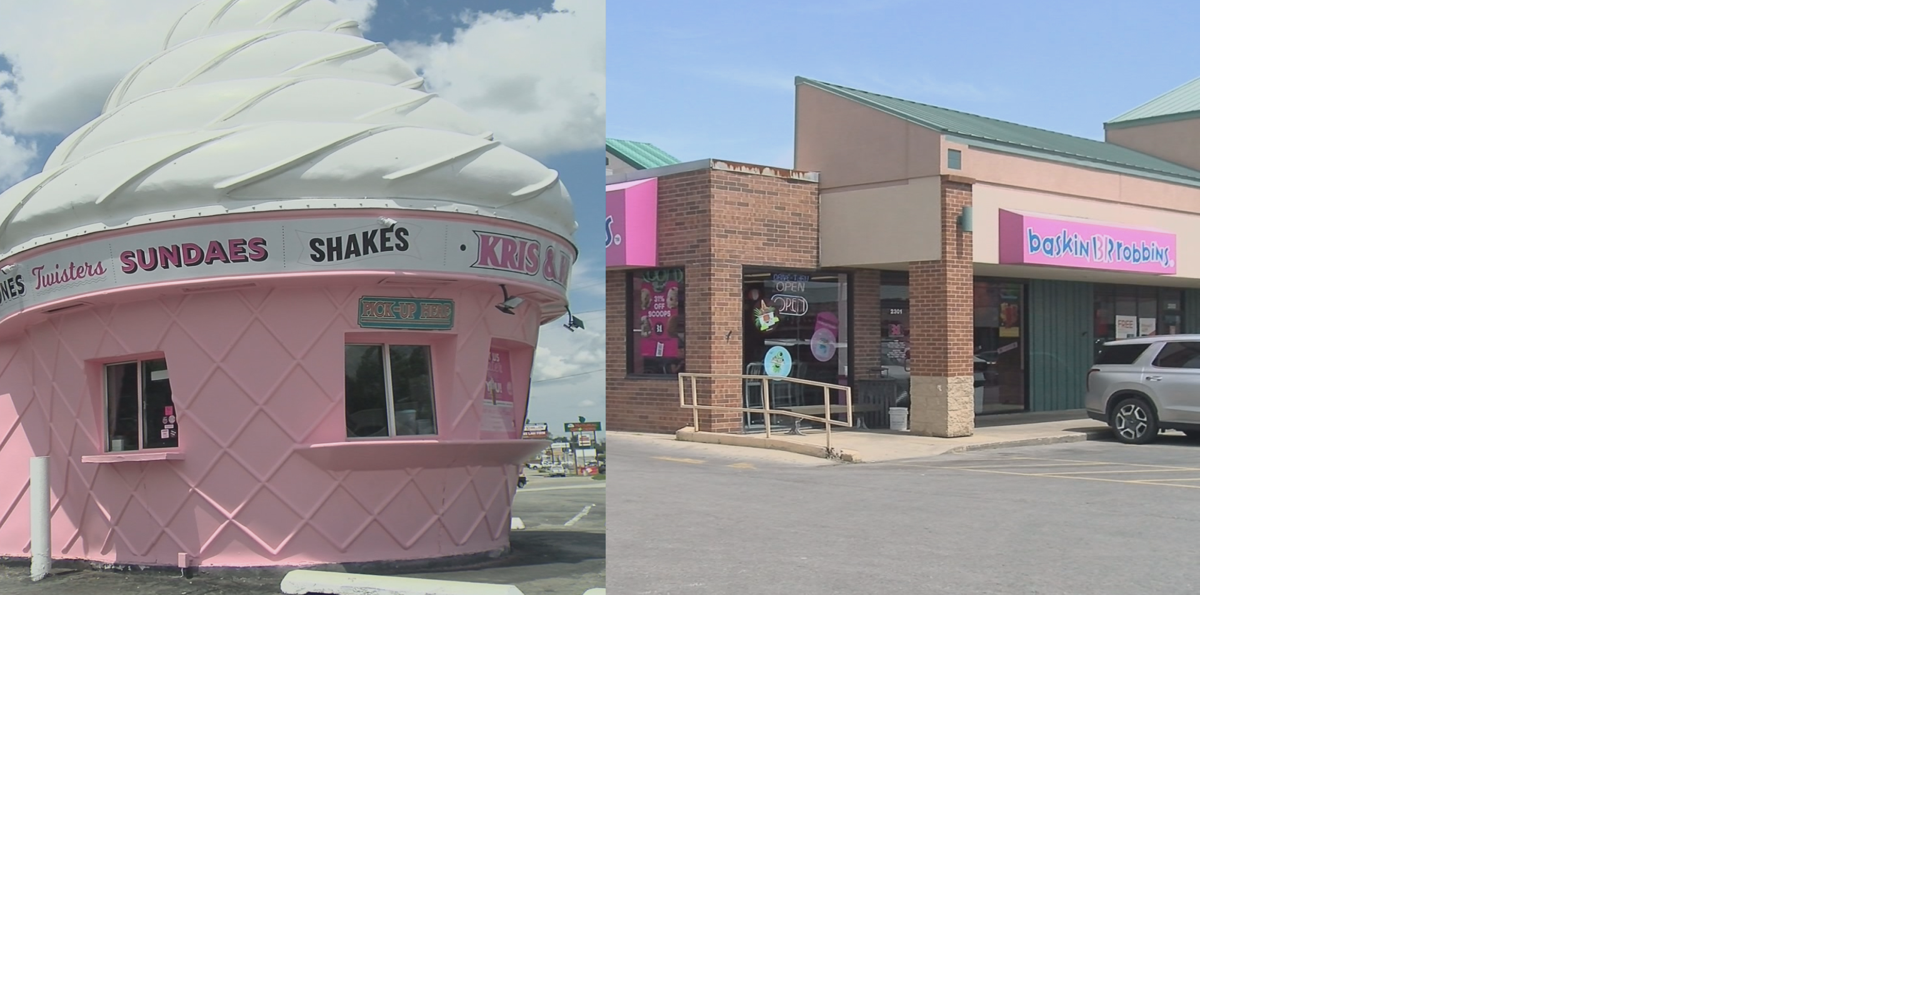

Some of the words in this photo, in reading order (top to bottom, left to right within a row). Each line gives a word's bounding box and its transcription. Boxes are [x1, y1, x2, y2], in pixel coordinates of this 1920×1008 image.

[119, 236, 268, 275] SUNDAES
[309, 226, 410, 263] SHAKES
[477, 233, 540, 276] KRIS
[543, 247, 557, 280] &
[1027, 227, 1090, 259] baskin
[1115, 240, 1169, 267] robbins
[31, 260, 107, 290] Twisters
[776, 281, 806, 292] OPEN
